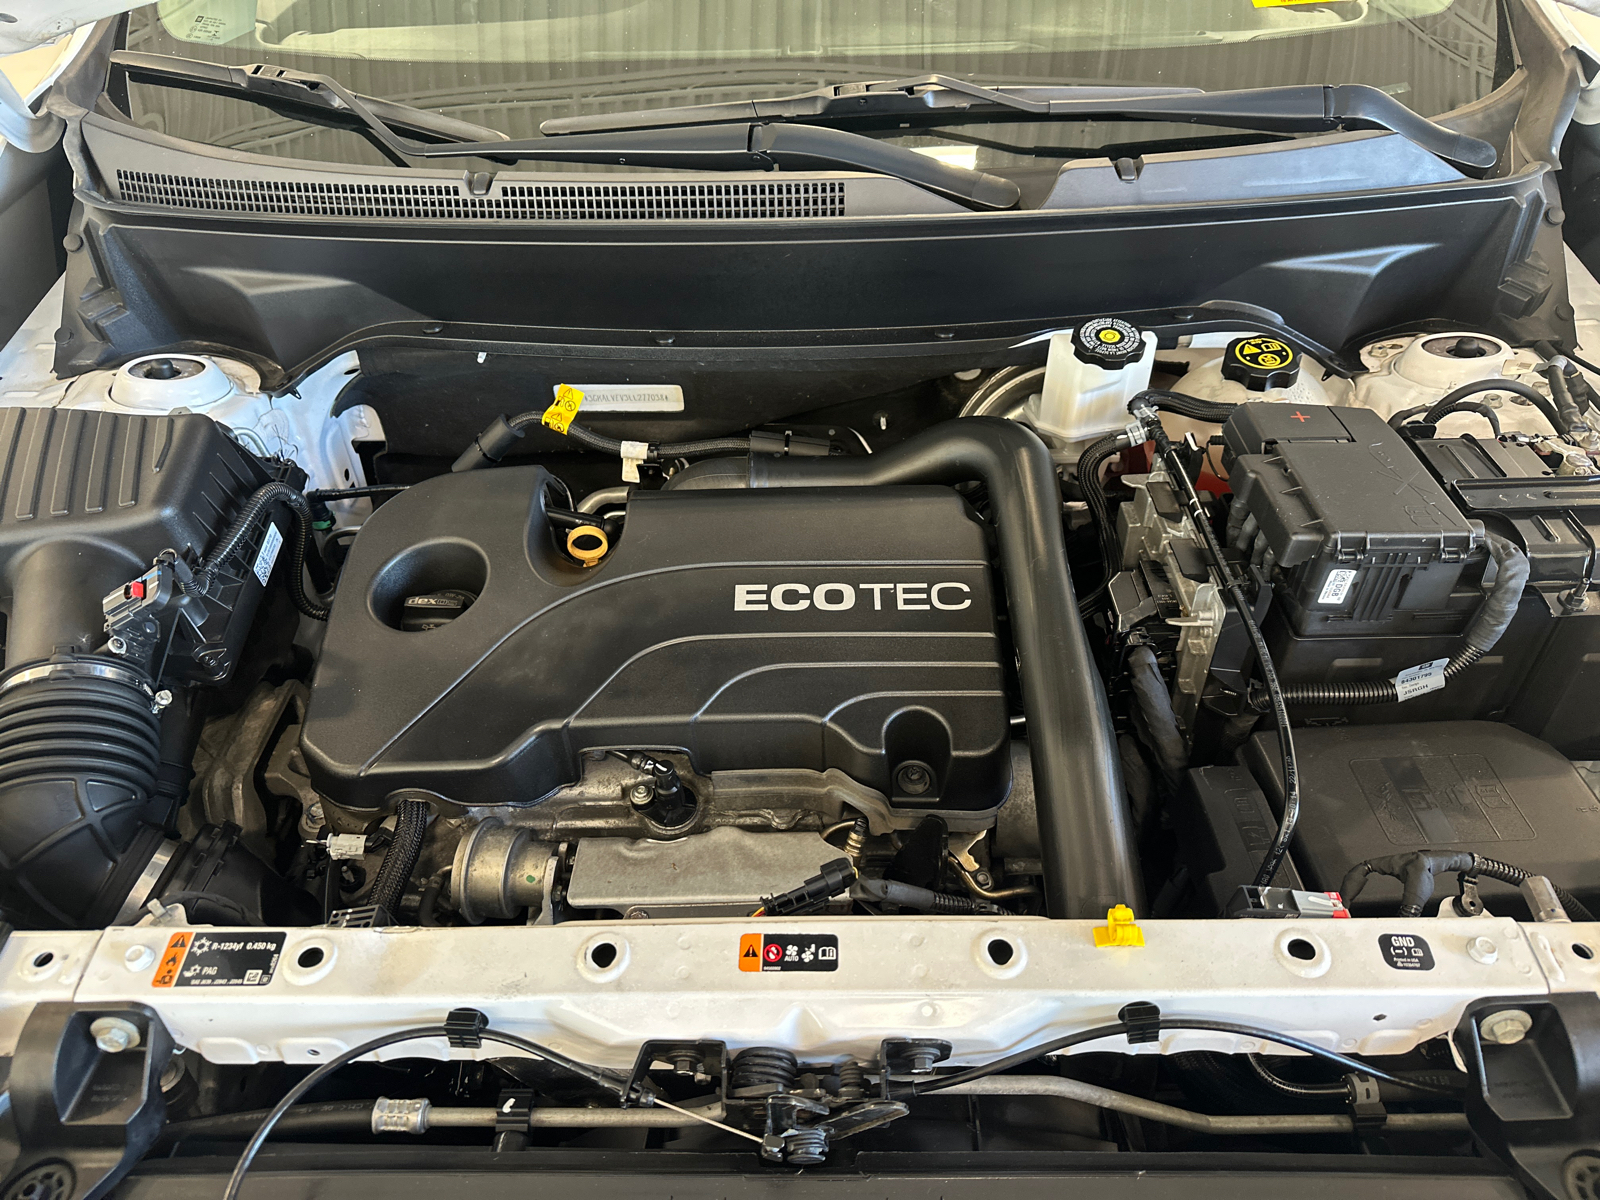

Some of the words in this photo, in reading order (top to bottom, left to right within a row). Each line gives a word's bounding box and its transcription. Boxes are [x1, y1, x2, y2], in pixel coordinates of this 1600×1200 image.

[408, 596, 458, 607] dexos
[733, 582, 972, 611] ECOTEC
[211, 942, 244, 952] R-1234yf
[246, 942, 266, 950] 0.450
[267, 942, 277, 951] kg
[1391, 936, 1415, 947] GND
